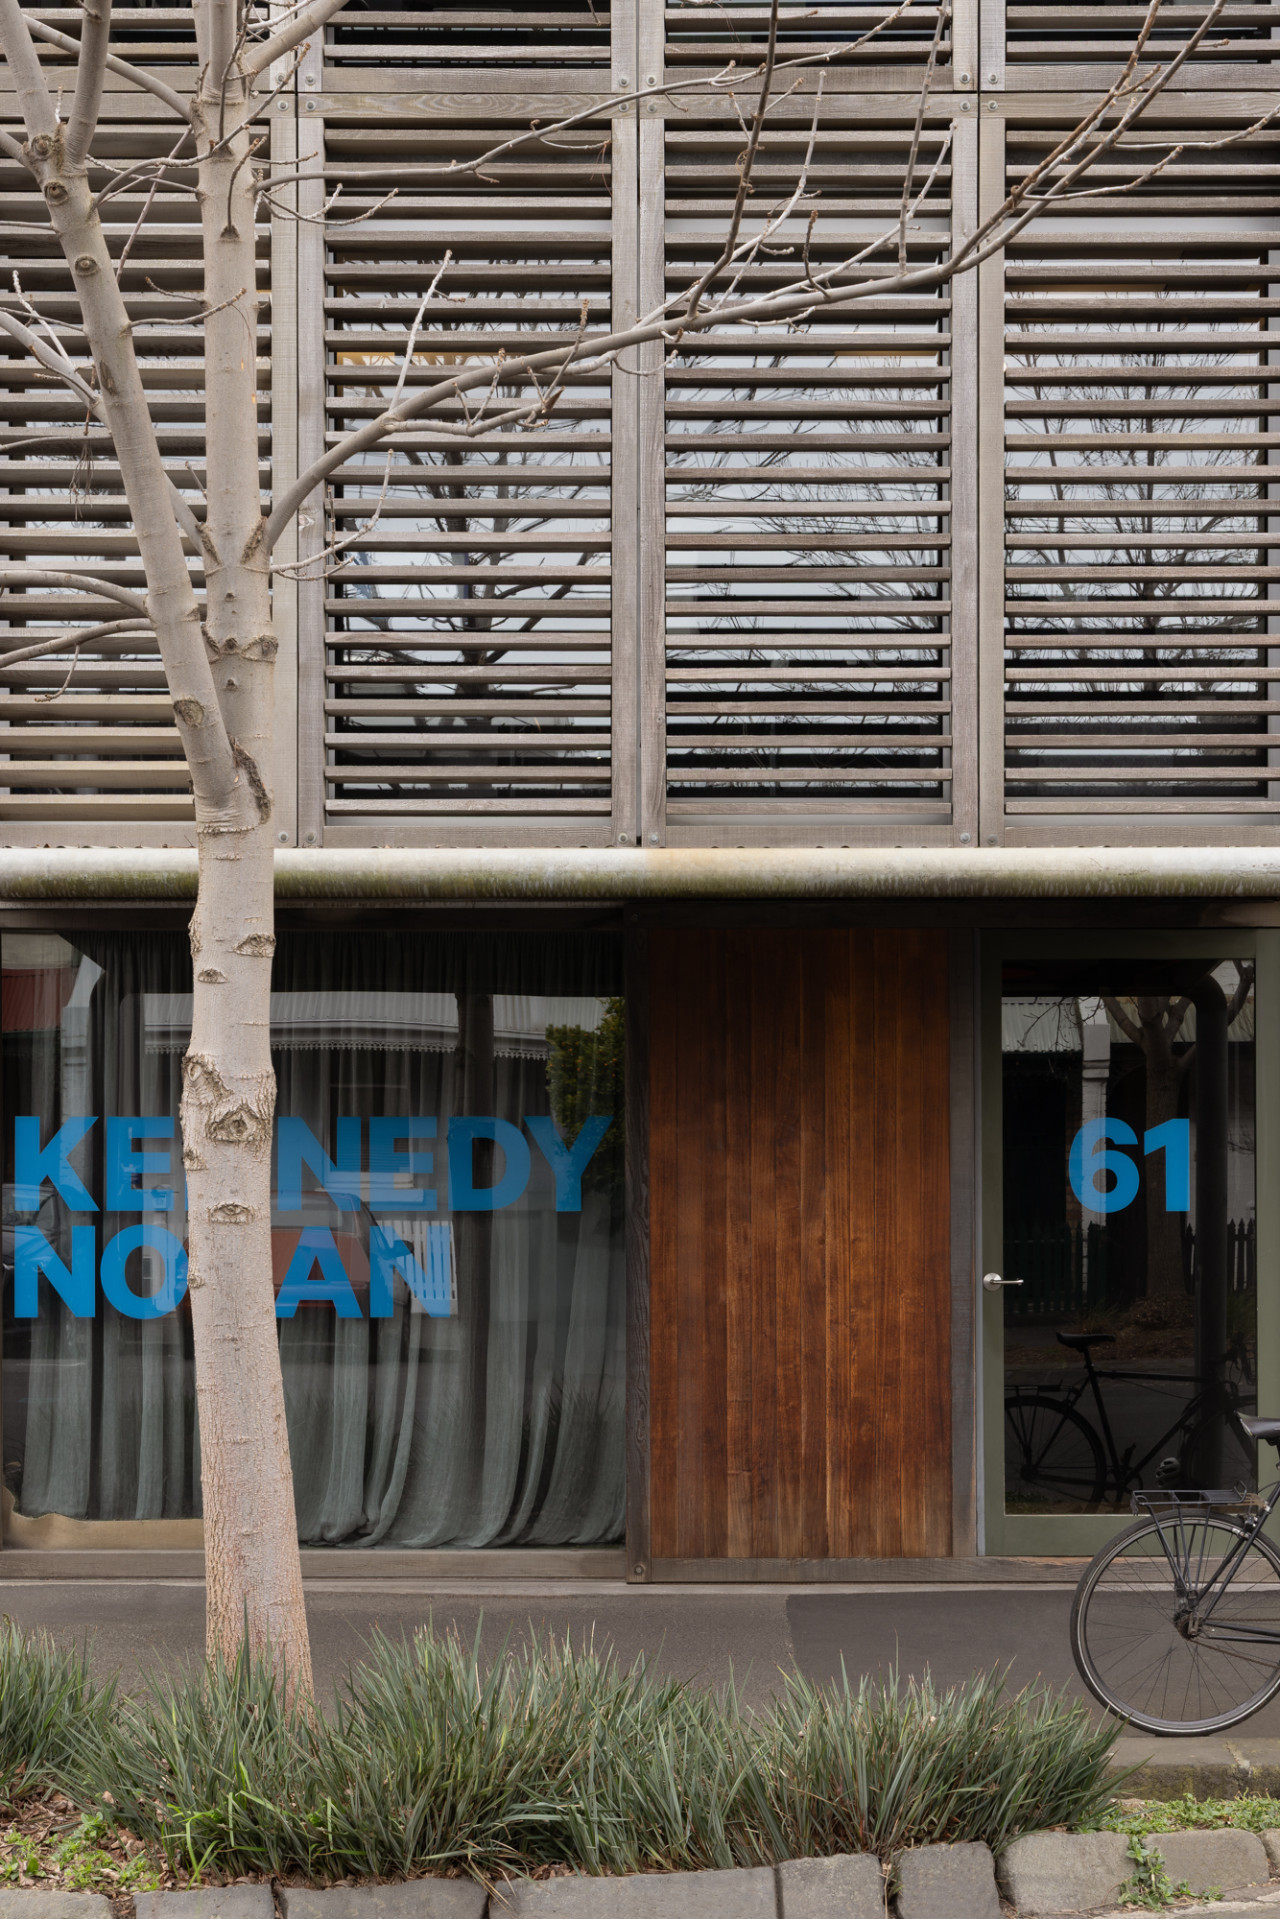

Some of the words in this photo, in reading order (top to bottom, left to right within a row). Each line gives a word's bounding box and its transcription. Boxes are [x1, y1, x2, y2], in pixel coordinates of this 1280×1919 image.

[15, 1116, 613, 1211] KENEDY
[1069, 1117, 1190, 1213] 61
[14, 1224, 451, 1319] NOAN
